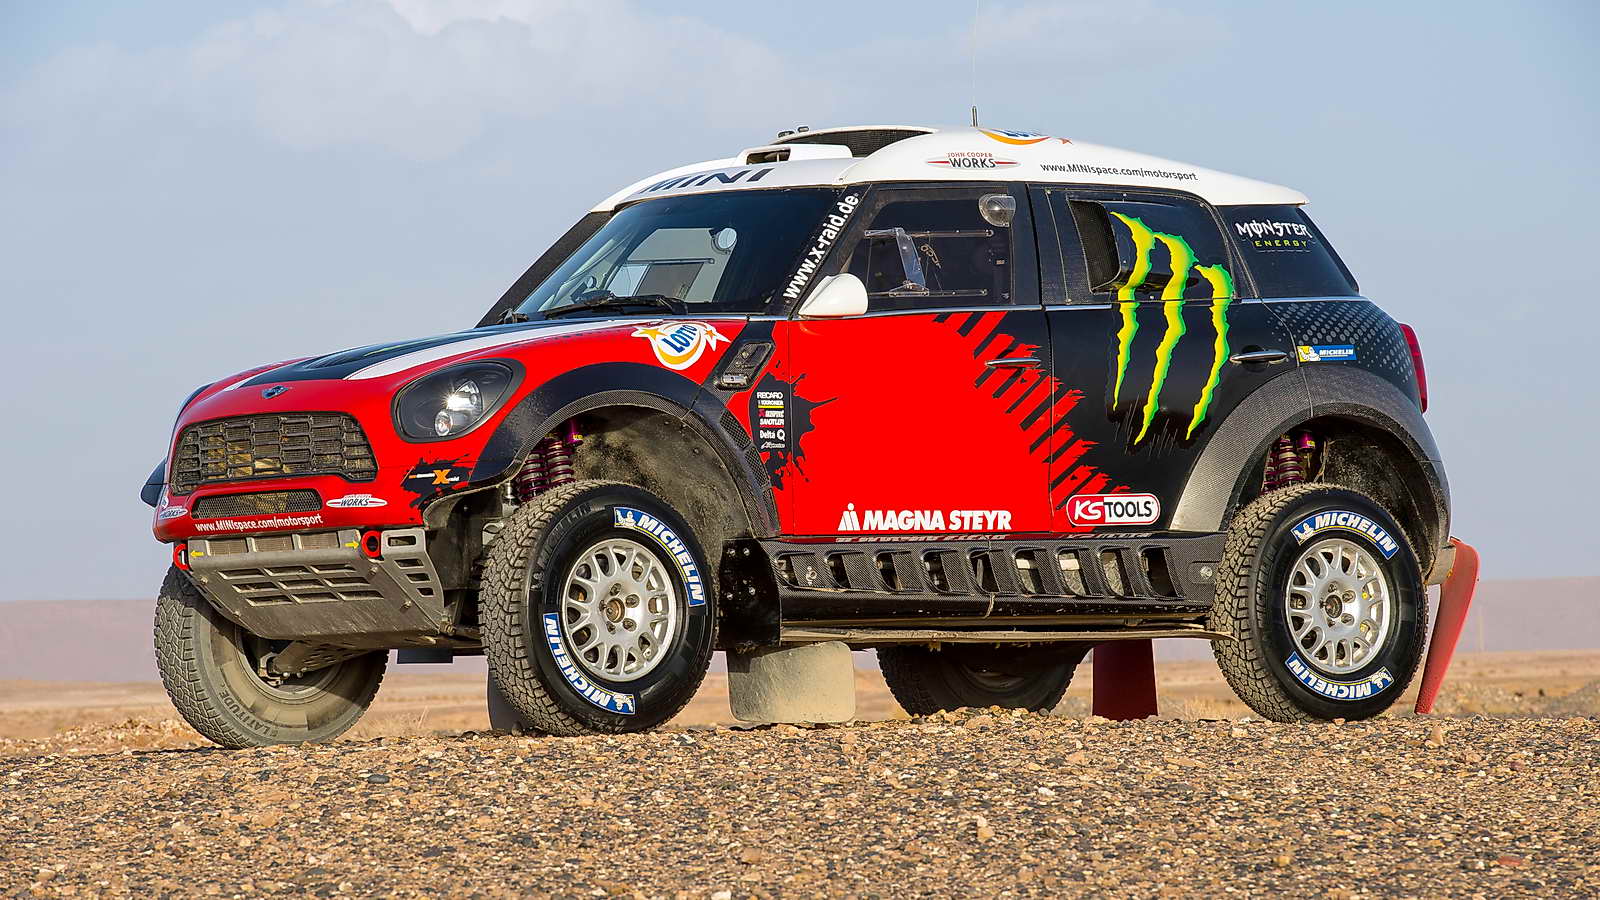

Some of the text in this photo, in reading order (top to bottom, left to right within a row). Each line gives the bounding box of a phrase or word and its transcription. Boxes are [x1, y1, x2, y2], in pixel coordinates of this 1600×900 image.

[949, 158, 996, 168] WORKS
[1040, 164, 1199, 182] www.MINIspace.com/motorsport
[639, 168, 775, 194] MINI
[783, 194, 859, 299] www.x-raid.de
[660, 325, 698, 353] LOTTO
[340, 498, 370, 507] WORKS
[194, 513, 324, 532] www.MINIspace.com/motorsport
[862, 510, 1012, 531] MAGNA STEYR
[1314, 512, 1397, 552] MICHELIN
[637, 515, 704, 603] MICHELIN
[544, 615, 611, 705] MICHELIN
[1288, 657, 1373, 699] MICHELIN
